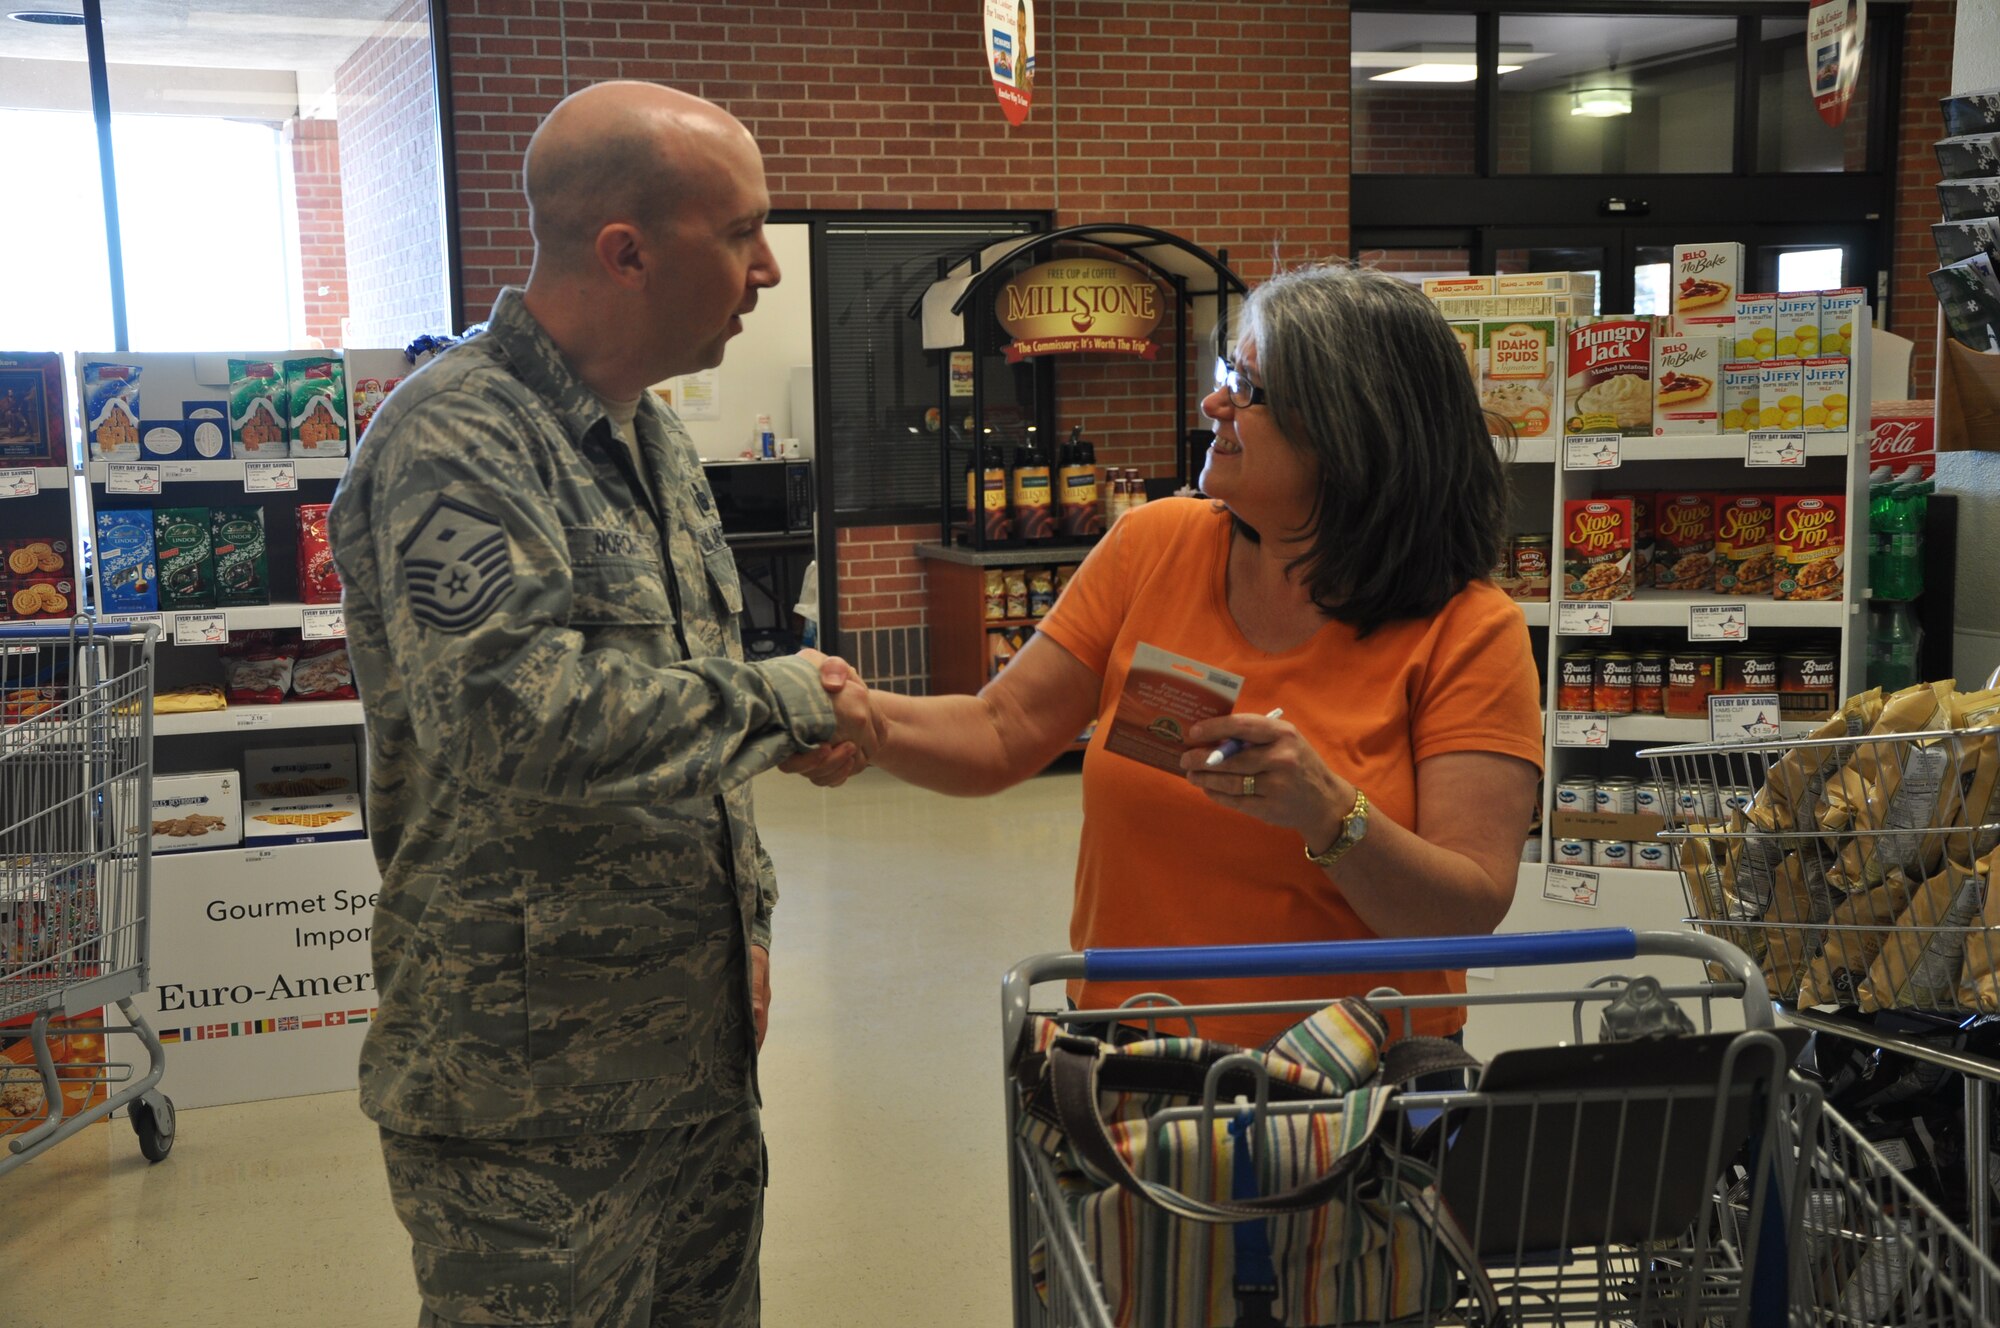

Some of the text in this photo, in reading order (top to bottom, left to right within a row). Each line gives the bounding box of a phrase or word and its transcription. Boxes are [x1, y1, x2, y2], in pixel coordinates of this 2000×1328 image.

[1048, 268, 1064, 279] FREE
[1066, 268, 1080, 278] CUP
[1092, 268, 1117, 278] COFFEE
[1007, 284, 1156, 320] MILLSTONE
[1779, 302, 1816, 312] JIFFY
[1737, 305, 1774, 315] JIFFY
[1094, 338, 1116, 349] Worth
[1118, 340, 1130, 350] The
[1576, 327, 1645, 351] Hungry
[1497, 340, 1539, 350] IDAHO
[1497, 352, 1538, 362] SPUDS
[1586, 342, 1631, 366] Jack
[1592, 365, 1618, 376] Mashed
[1806, 369, 1846, 380] JIFFY
[1762, 371, 1800, 382] JIFFY
[1871, 421, 1921, 453] Cola
[1660, 506, 1711, 534] Stove
[1720, 508, 1773, 538] Stove
[1779, 509, 1836, 541] Stove
[1569, 513, 1622, 543] Stove
[1680, 523, 1704, 542] Top
[1738, 526, 1766, 545] Top
[1799, 528, 1827, 548] Top
[1587, 531, 1614, 552] Top
[1588, 554, 1613, 564] TURKEY
[1563, 663, 1590, 673] Bruce's
[1604, 663, 1631, 674] Bruce's
[1635, 663, 1661, 672] Bruce's
[1669, 658, 1694, 671] Bruce's
[1742, 660, 1775, 674] Bruce's
[1801, 660, 1833, 674] Bruce's
[1563, 674, 1592, 684] YAMS
[1604, 675, 1632, 684] YAMS
[1634, 674, 1662, 684] YAMS
[1744, 675, 1775, 684] YAMS
[1802, 675, 1834, 684] YAMS
[1714, 699, 1735, 707] EVERY
[1753, 727, 1772, 735] $1.59
[206, 890, 379, 921] Gourmet Spe
[296, 926, 372, 950] Impor
